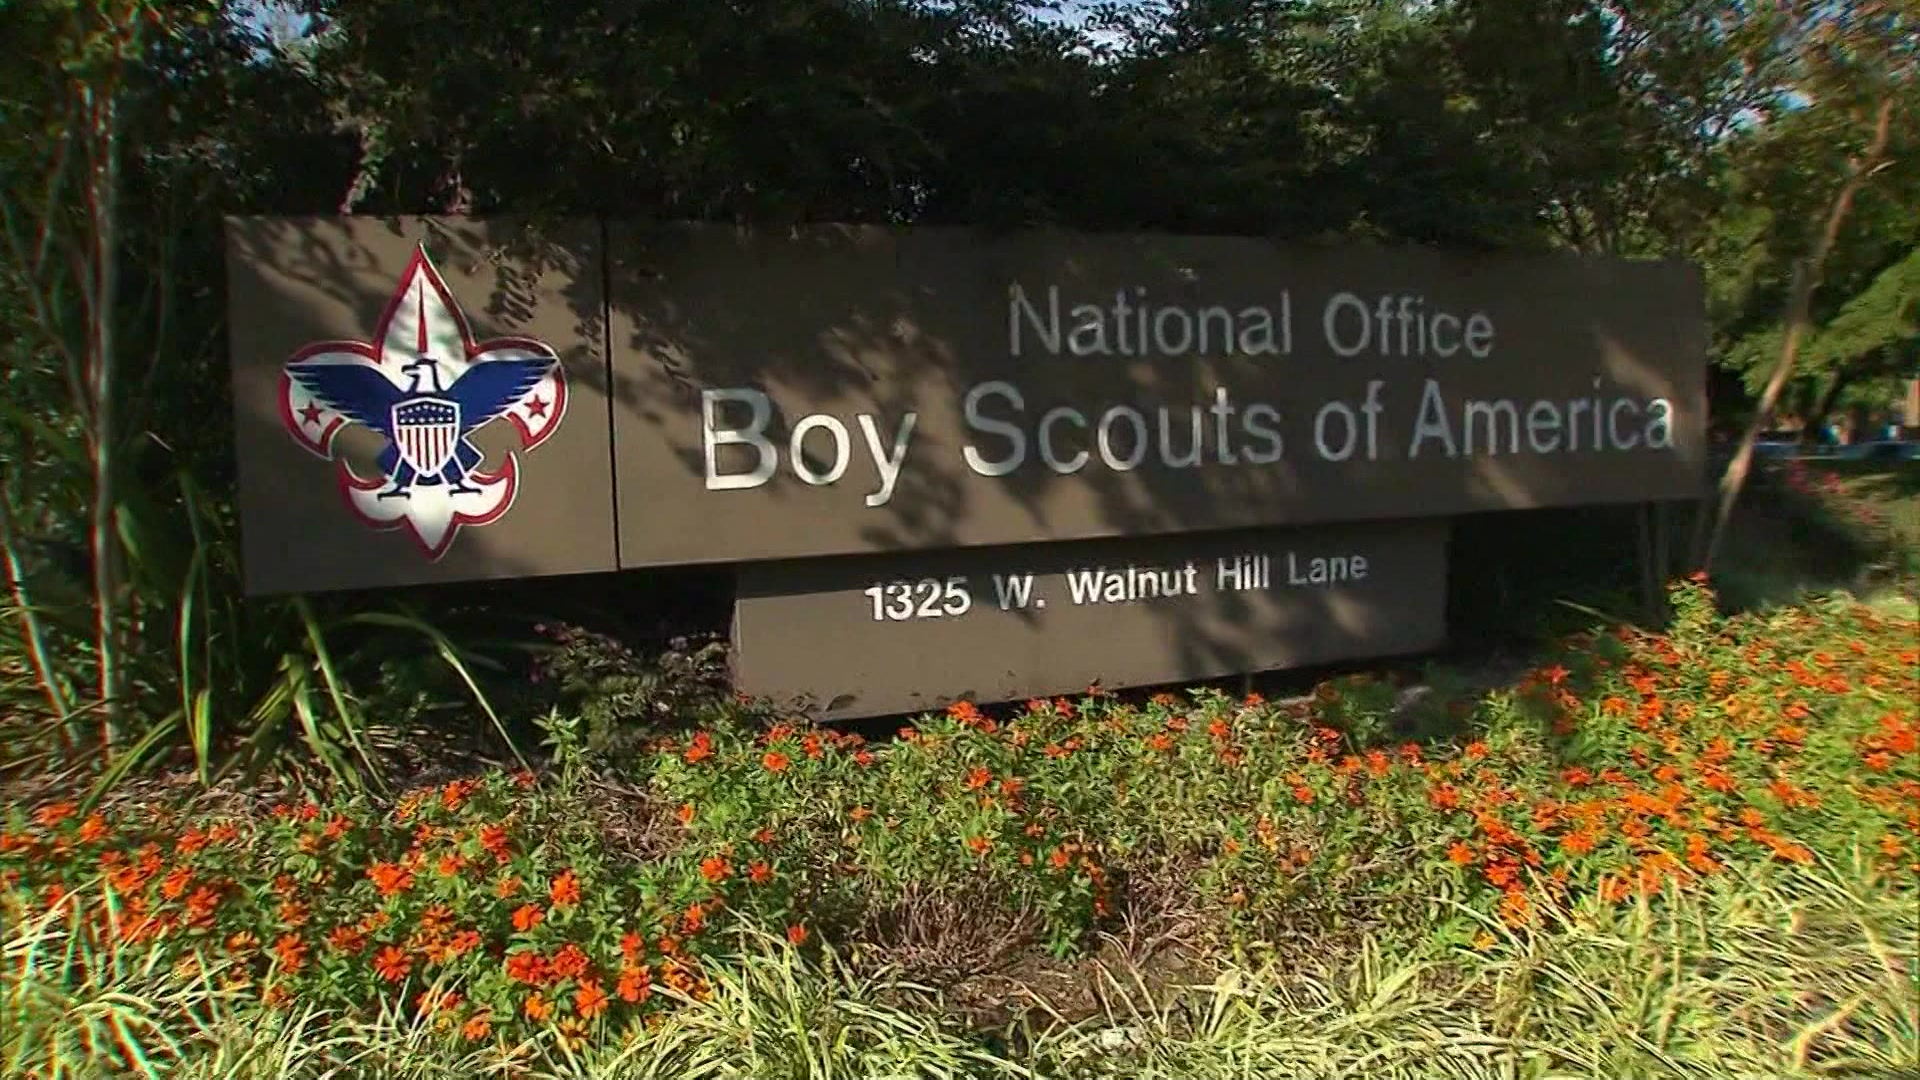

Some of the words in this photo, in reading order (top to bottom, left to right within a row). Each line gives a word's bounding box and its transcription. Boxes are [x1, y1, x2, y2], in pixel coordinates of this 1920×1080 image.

[1009, 285, 1292, 357] National
[1323, 293, 1496, 357] Office
[702, 388, 917, 507] Boy
[963, 380, 1284, 477] Scouts
[1314, 379, 1385, 461] of
[1408, 378, 1674, 459] America
[865, 577, 972, 622] 1325
[993, 573, 1045, 610] W.
[1067, 563, 1198, 605] Walnut
[1216, 556, 1270, 591] Hill
[1288, 552, 1369, 587] Lane
